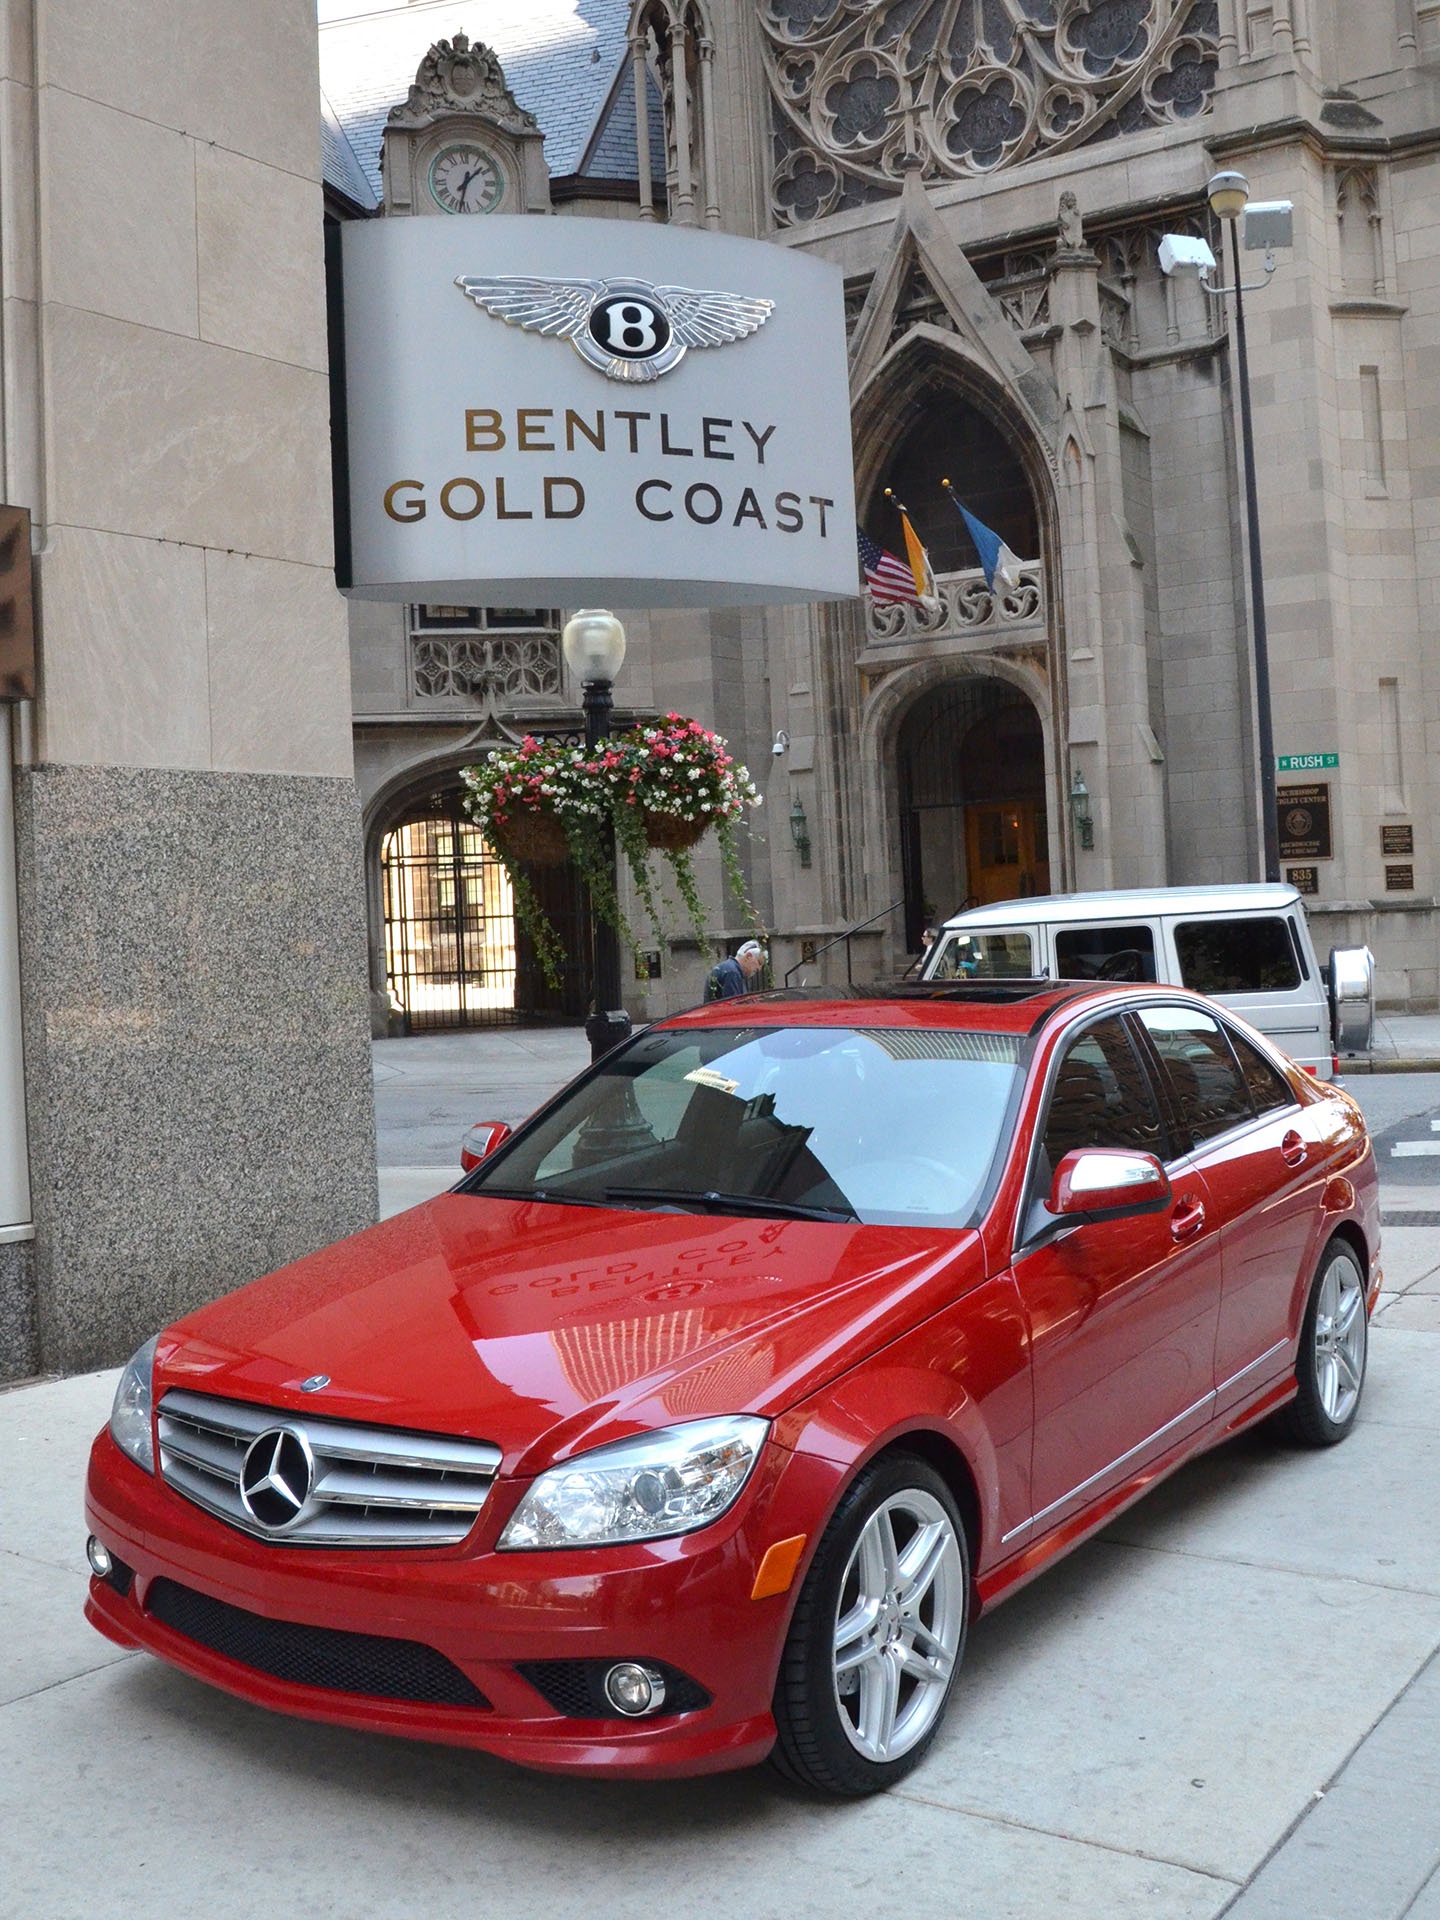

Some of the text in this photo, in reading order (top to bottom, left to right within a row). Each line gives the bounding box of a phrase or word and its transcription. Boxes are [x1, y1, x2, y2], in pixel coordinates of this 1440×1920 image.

[606, 302, 656, 352] B
[465, 408, 776, 464] BENTLEY
[383, 476, 834, 538] GOLD COAST
[1290, 755, 1323, 768] RUSH
[1292, 869, 1312, 881] 835
